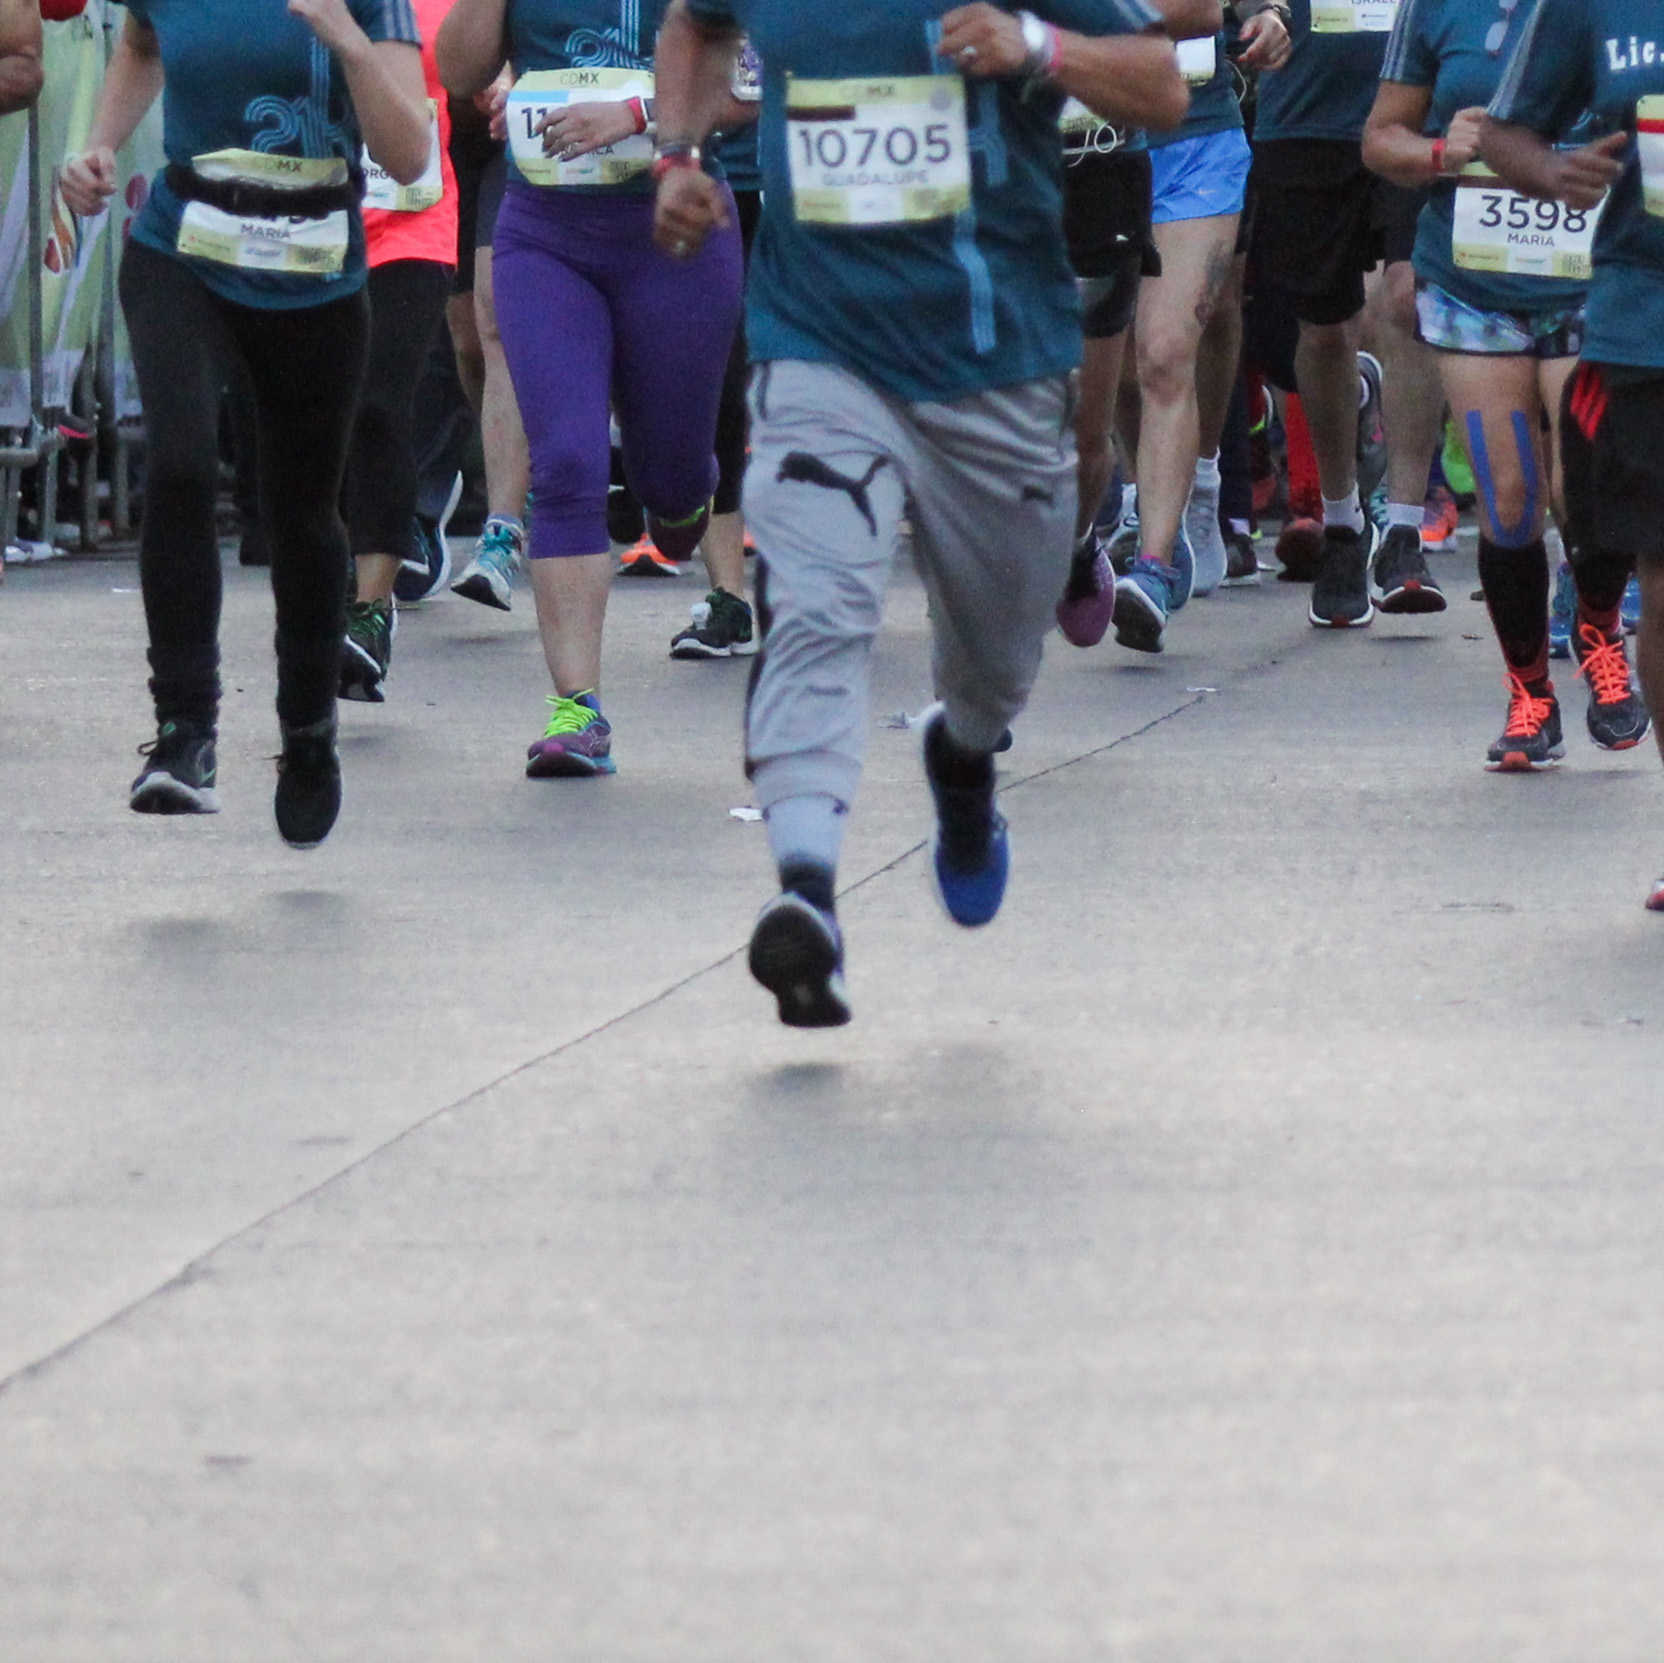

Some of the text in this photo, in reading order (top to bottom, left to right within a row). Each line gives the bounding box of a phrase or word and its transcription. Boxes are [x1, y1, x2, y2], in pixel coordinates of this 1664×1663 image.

[798, 124, 952, 168] 10705
[823, 169, 929, 186] GUADALUPE
[1479, 194, 1588, 233] 3598
[1506, 232, 1556, 247] MARIA
